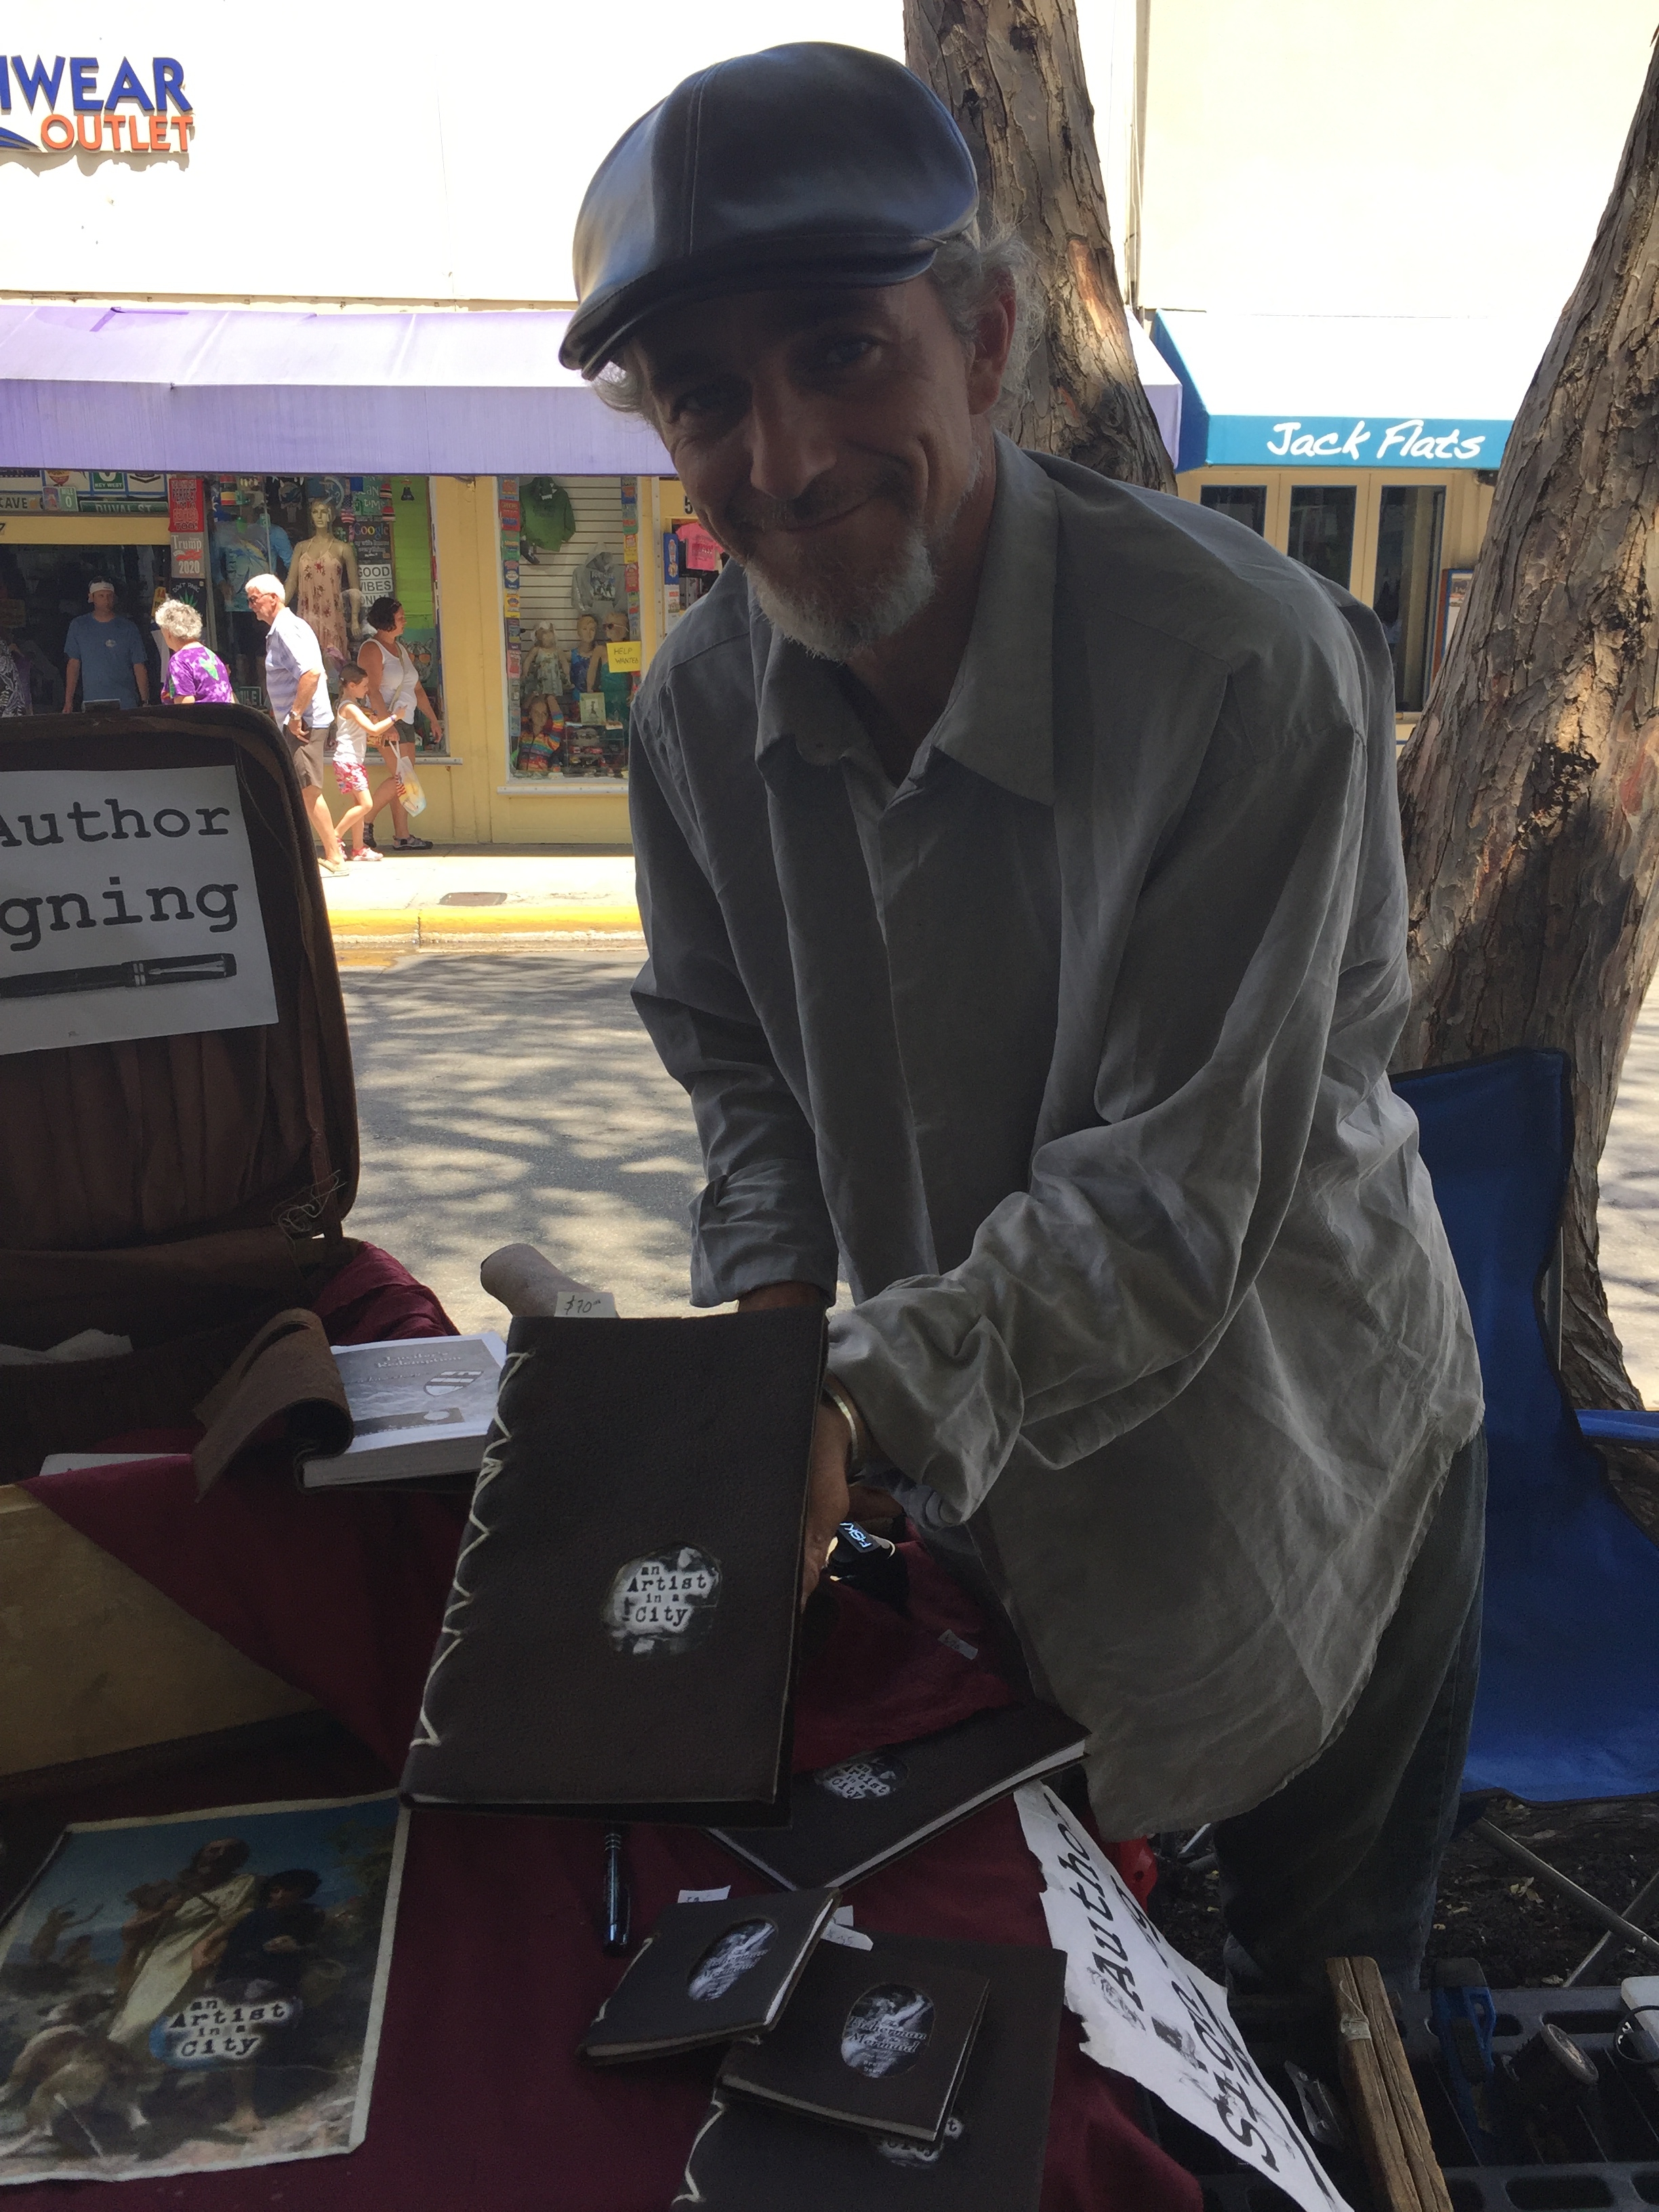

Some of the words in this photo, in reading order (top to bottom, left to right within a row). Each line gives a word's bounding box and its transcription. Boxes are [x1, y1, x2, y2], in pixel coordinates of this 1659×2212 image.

[0, 54, 193, 112] WEAR
[41, 114, 193, 151] OUTLET
[1267, 419, 1371, 460] Jack
[1376, 419, 1486, 459] Flats
[354, 523, 390, 540] Google
[171, 535, 202, 552] Trump
[178, 560, 200, 575] 2020
[358, 567, 390, 577] GOOD
[614, 647, 632, 655] HELP
[0, 798, 230, 847] Author
[640, 1565, 660, 1576] an
[627, 1574, 708, 1593] Artist
[646, 1593, 662, 1603] in
[635, 1605, 689, 1627] City
[190, 2000, 218, 2011] an
[170, 2003, 285, 2028] Artist
[197, 2027, 220, 2037] in
[181, 2037, 260, 2057] City
